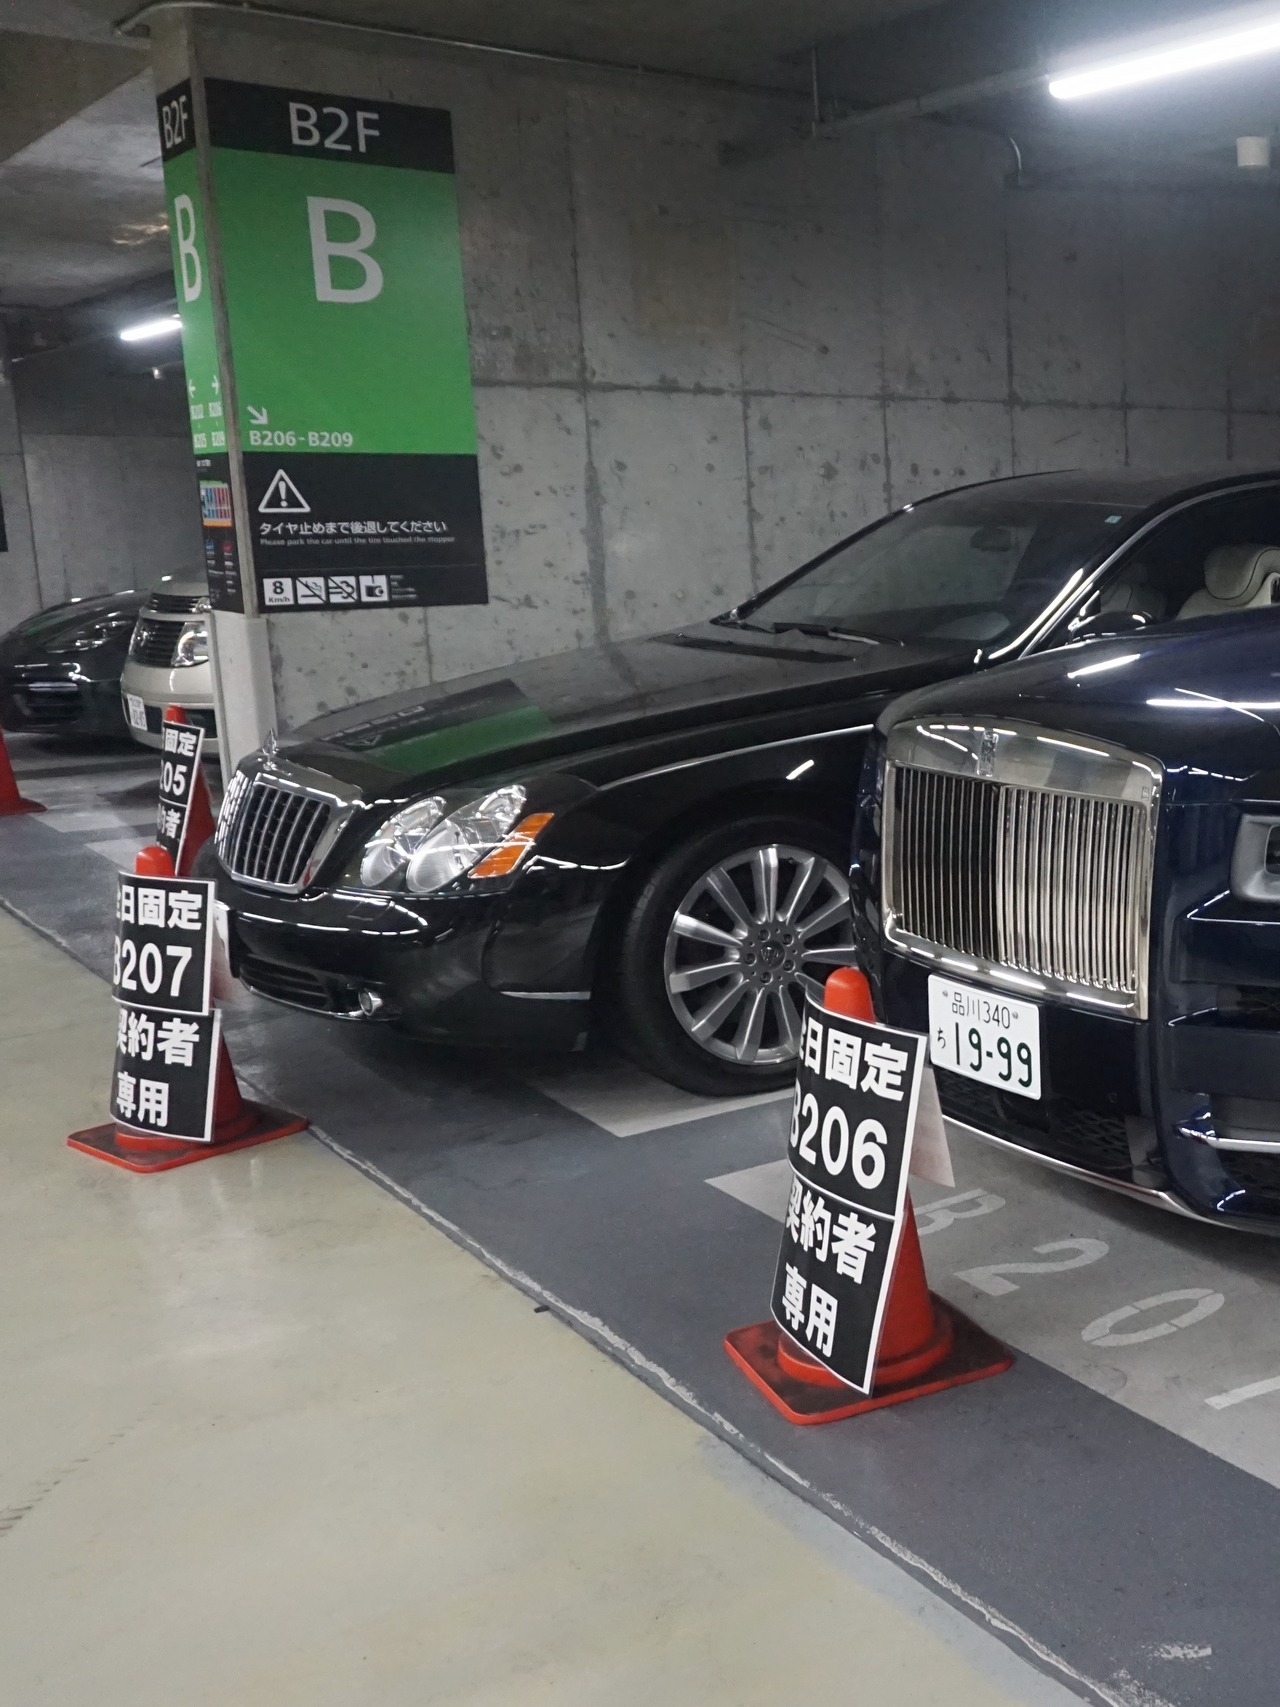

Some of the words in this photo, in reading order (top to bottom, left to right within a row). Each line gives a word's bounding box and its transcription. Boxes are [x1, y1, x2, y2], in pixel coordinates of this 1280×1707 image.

[162, 95, 188, 149] B2F
[288, 101, 380, 153] B2F
[174, 194, 201, 303] B
[306, 196, 383, 303] B
[259, 520, 448, 535] タイヤ止めまで後退してください
[260, 538, 286, 546] Please
[287, 538, 304, 547] park
[306, 537, 320, 545] the
[334, 537, 352, 545] until
[413, 536, 426, 544] the
[272, 580, 284, 595] 8
[162, 727, 197, 757] 固定
[937, 1027, 946, 1049] ち
[955, 1022, 1033, 1088] 19-99
[116, 1071, 169, 1127] 専用
[782, 1262, 838, 1358] 専用
